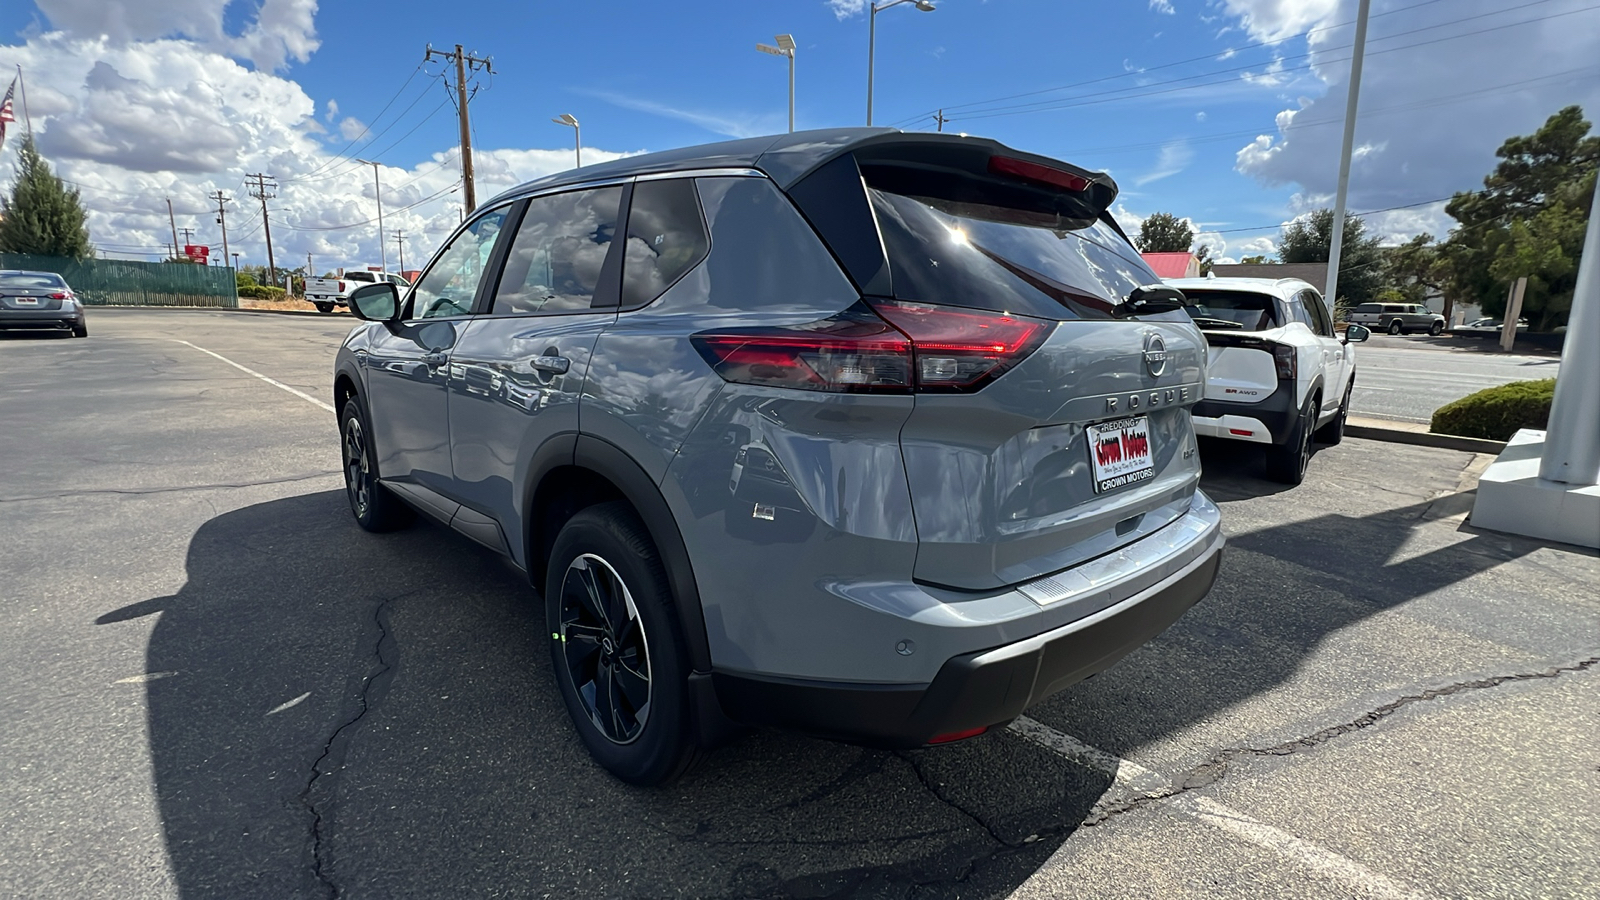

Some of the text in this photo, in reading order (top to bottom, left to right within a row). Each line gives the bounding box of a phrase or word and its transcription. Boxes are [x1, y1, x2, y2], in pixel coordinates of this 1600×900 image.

[1106, 387, 1188, 413] ROGUE
[1104, 419, 1135, 432] REDDING
[1101, 468, 1154, 491] CROWN MOTORS
